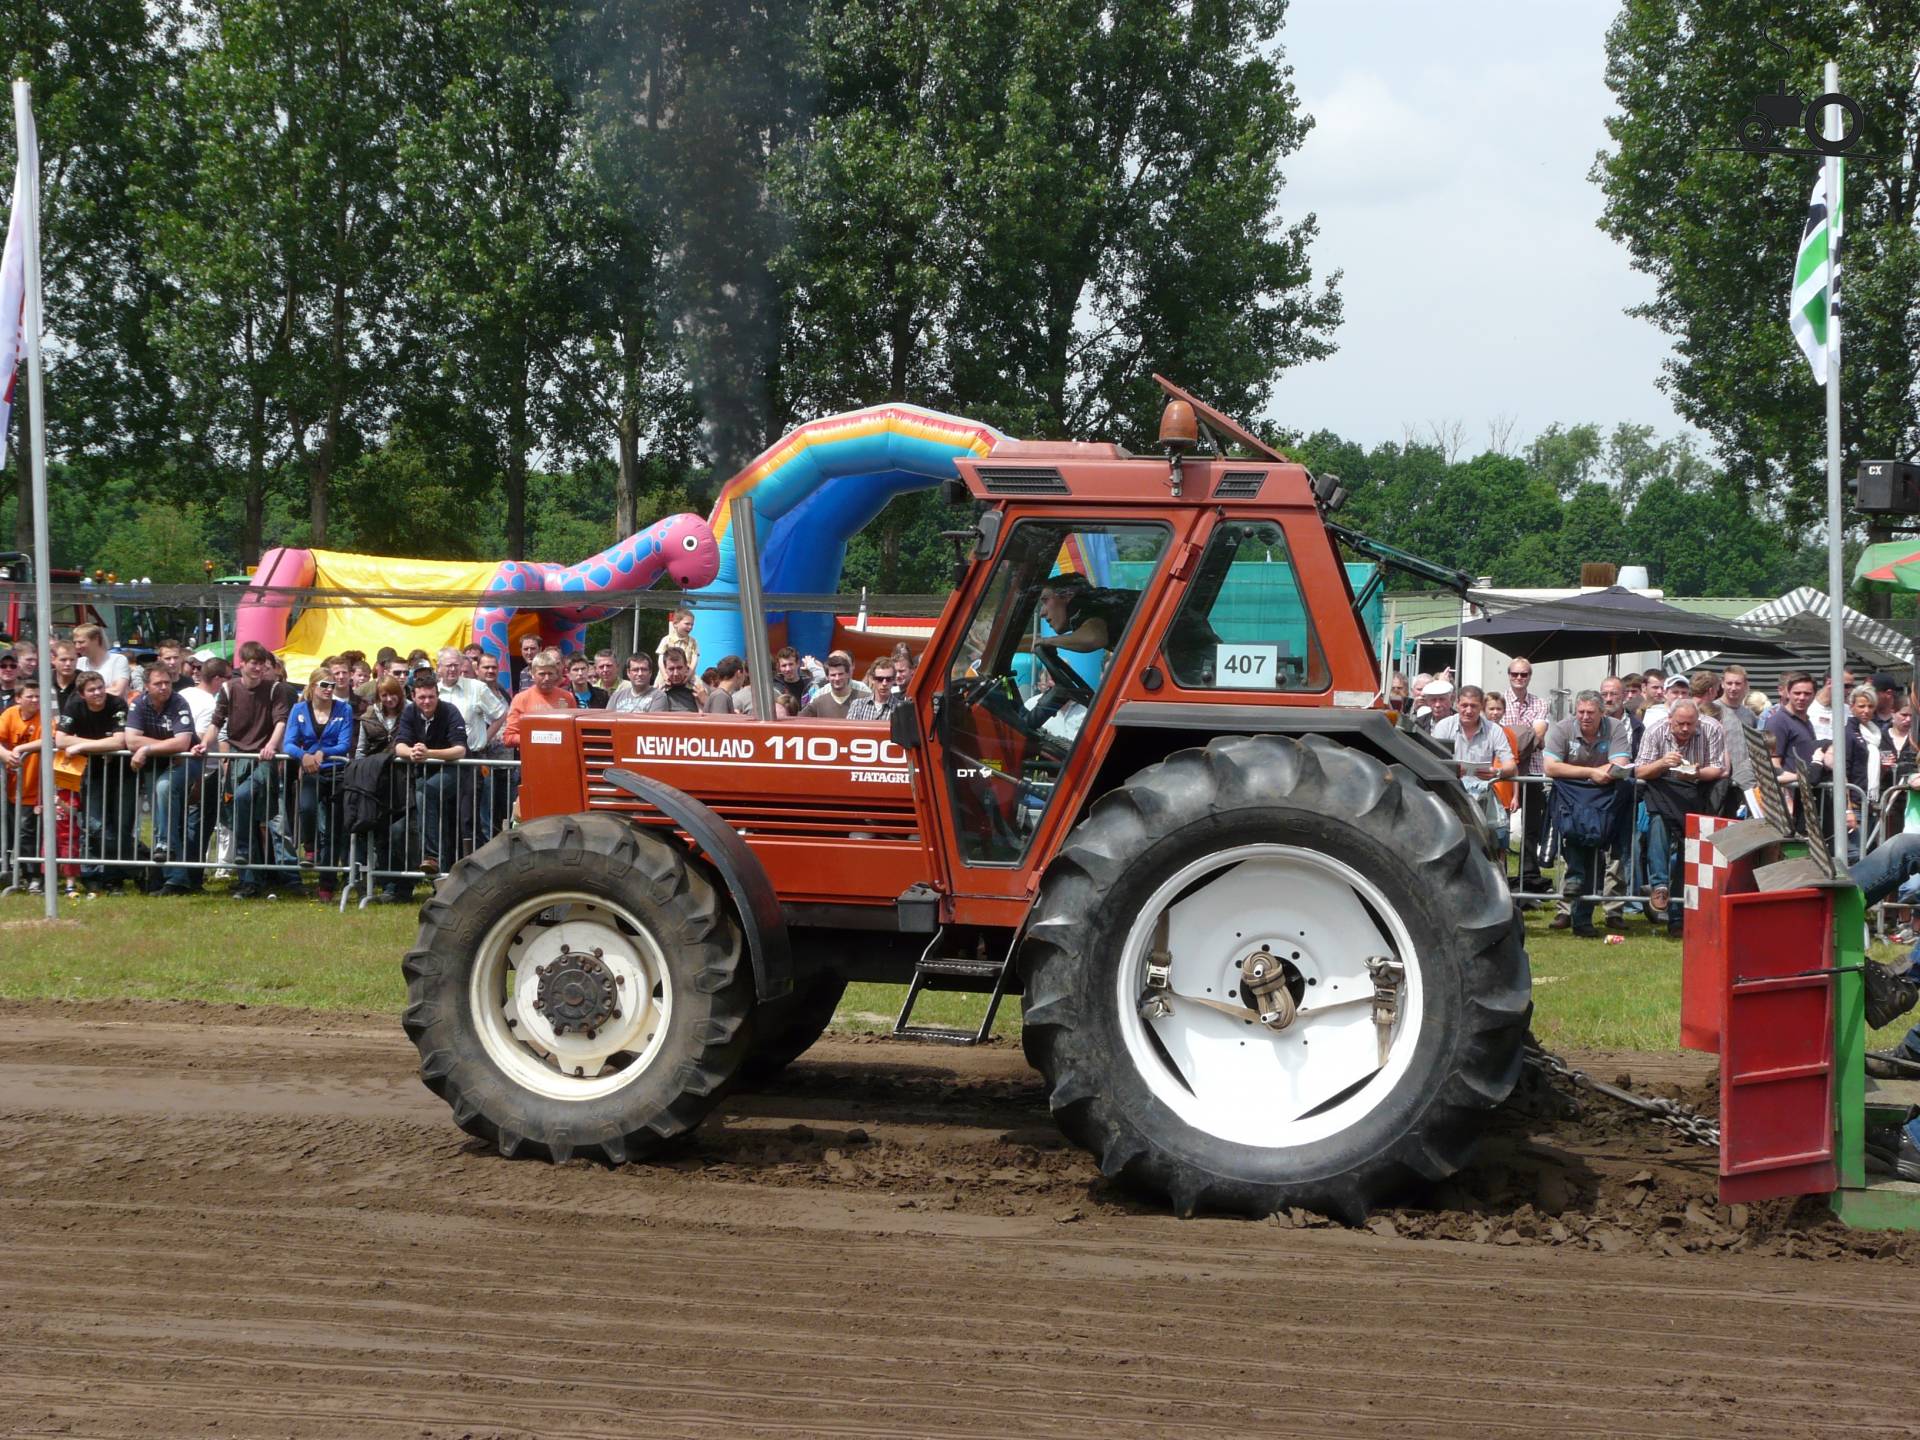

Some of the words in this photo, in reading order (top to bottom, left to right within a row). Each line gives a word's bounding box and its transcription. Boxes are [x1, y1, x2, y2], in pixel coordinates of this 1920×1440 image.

[1224, 655, 1266, 674] 407
[636, 736, 673, 755] NEW
[675, 737, 754, 758] HOLLAND
[764, 736, 907, 763] 110-90
[850, 771, 910, 783] FIATAGRI
[957, 768, 977, 778] DT
